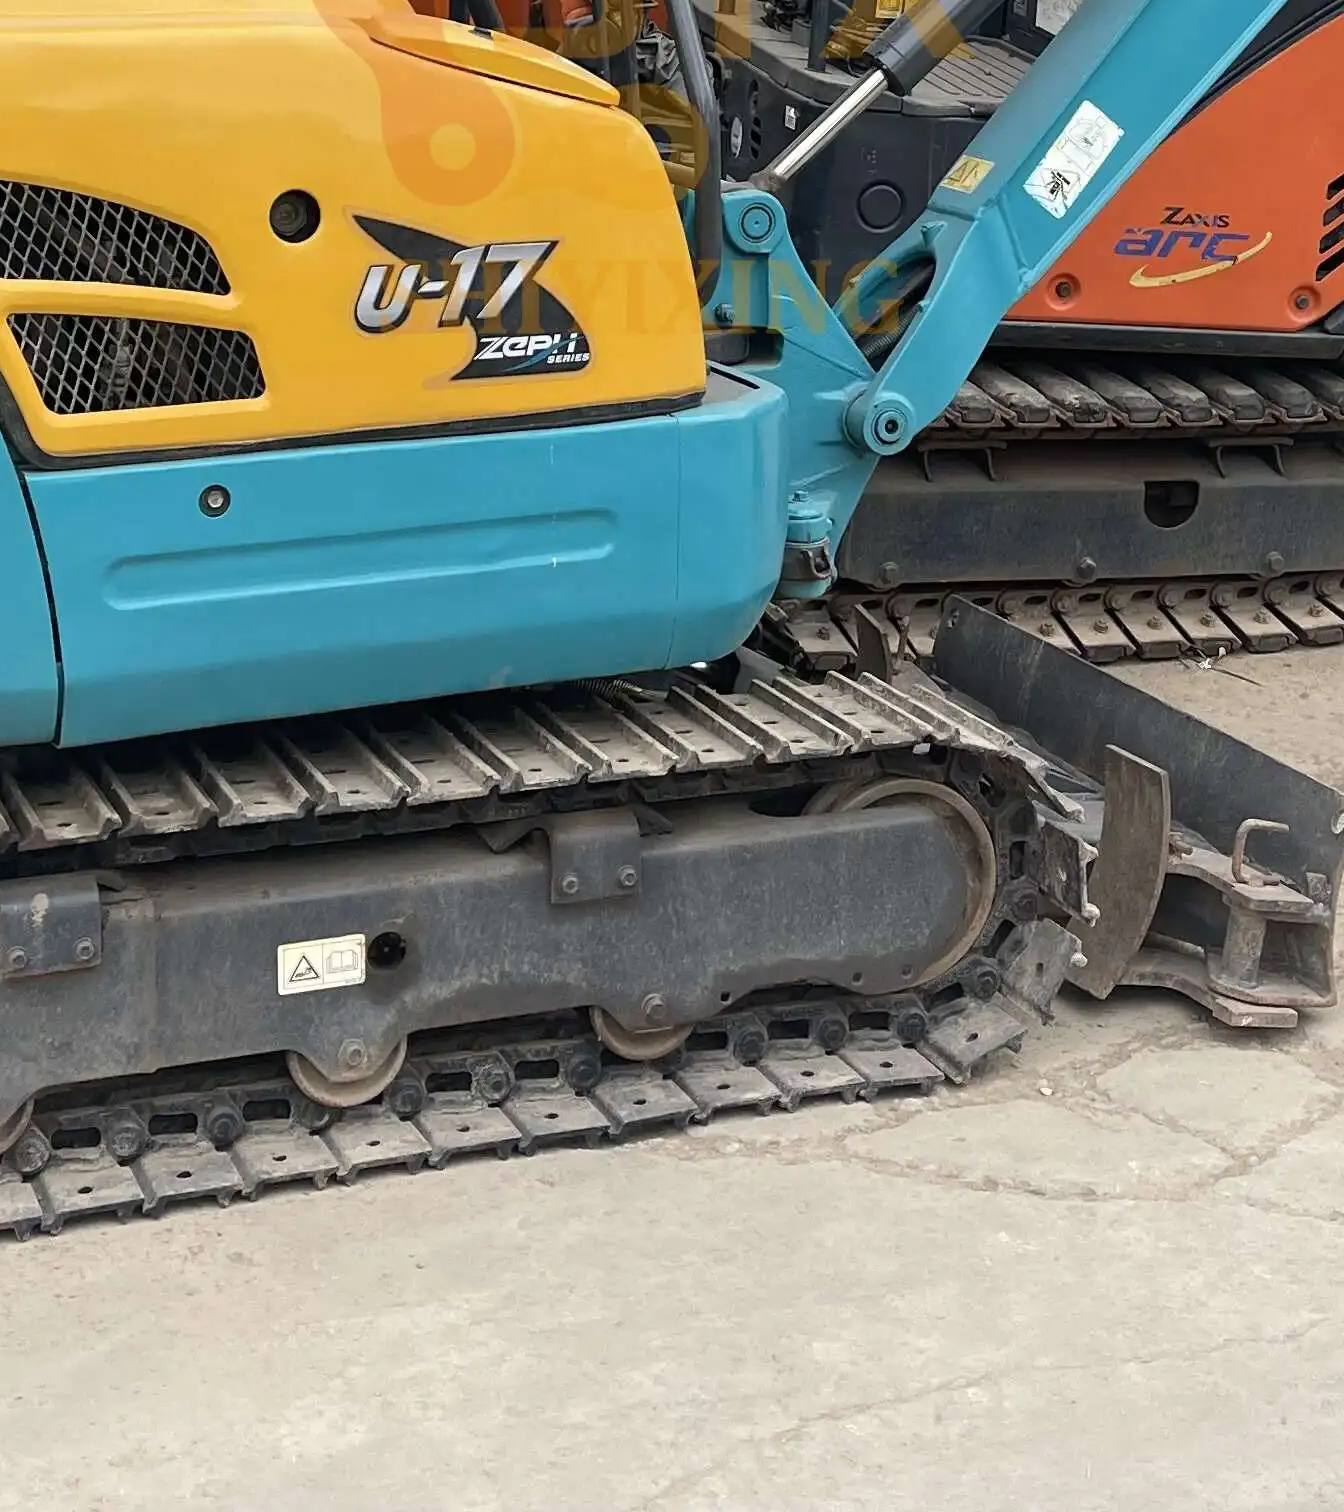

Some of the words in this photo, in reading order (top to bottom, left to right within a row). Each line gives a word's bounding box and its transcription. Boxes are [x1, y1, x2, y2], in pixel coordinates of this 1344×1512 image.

[1159, 206, 1230, 228] ZAXIS
[1113, 227, 1251, 262] arc
[354, 240, 560, 334] U-17
[546, 352, 591, 365] SERIES
